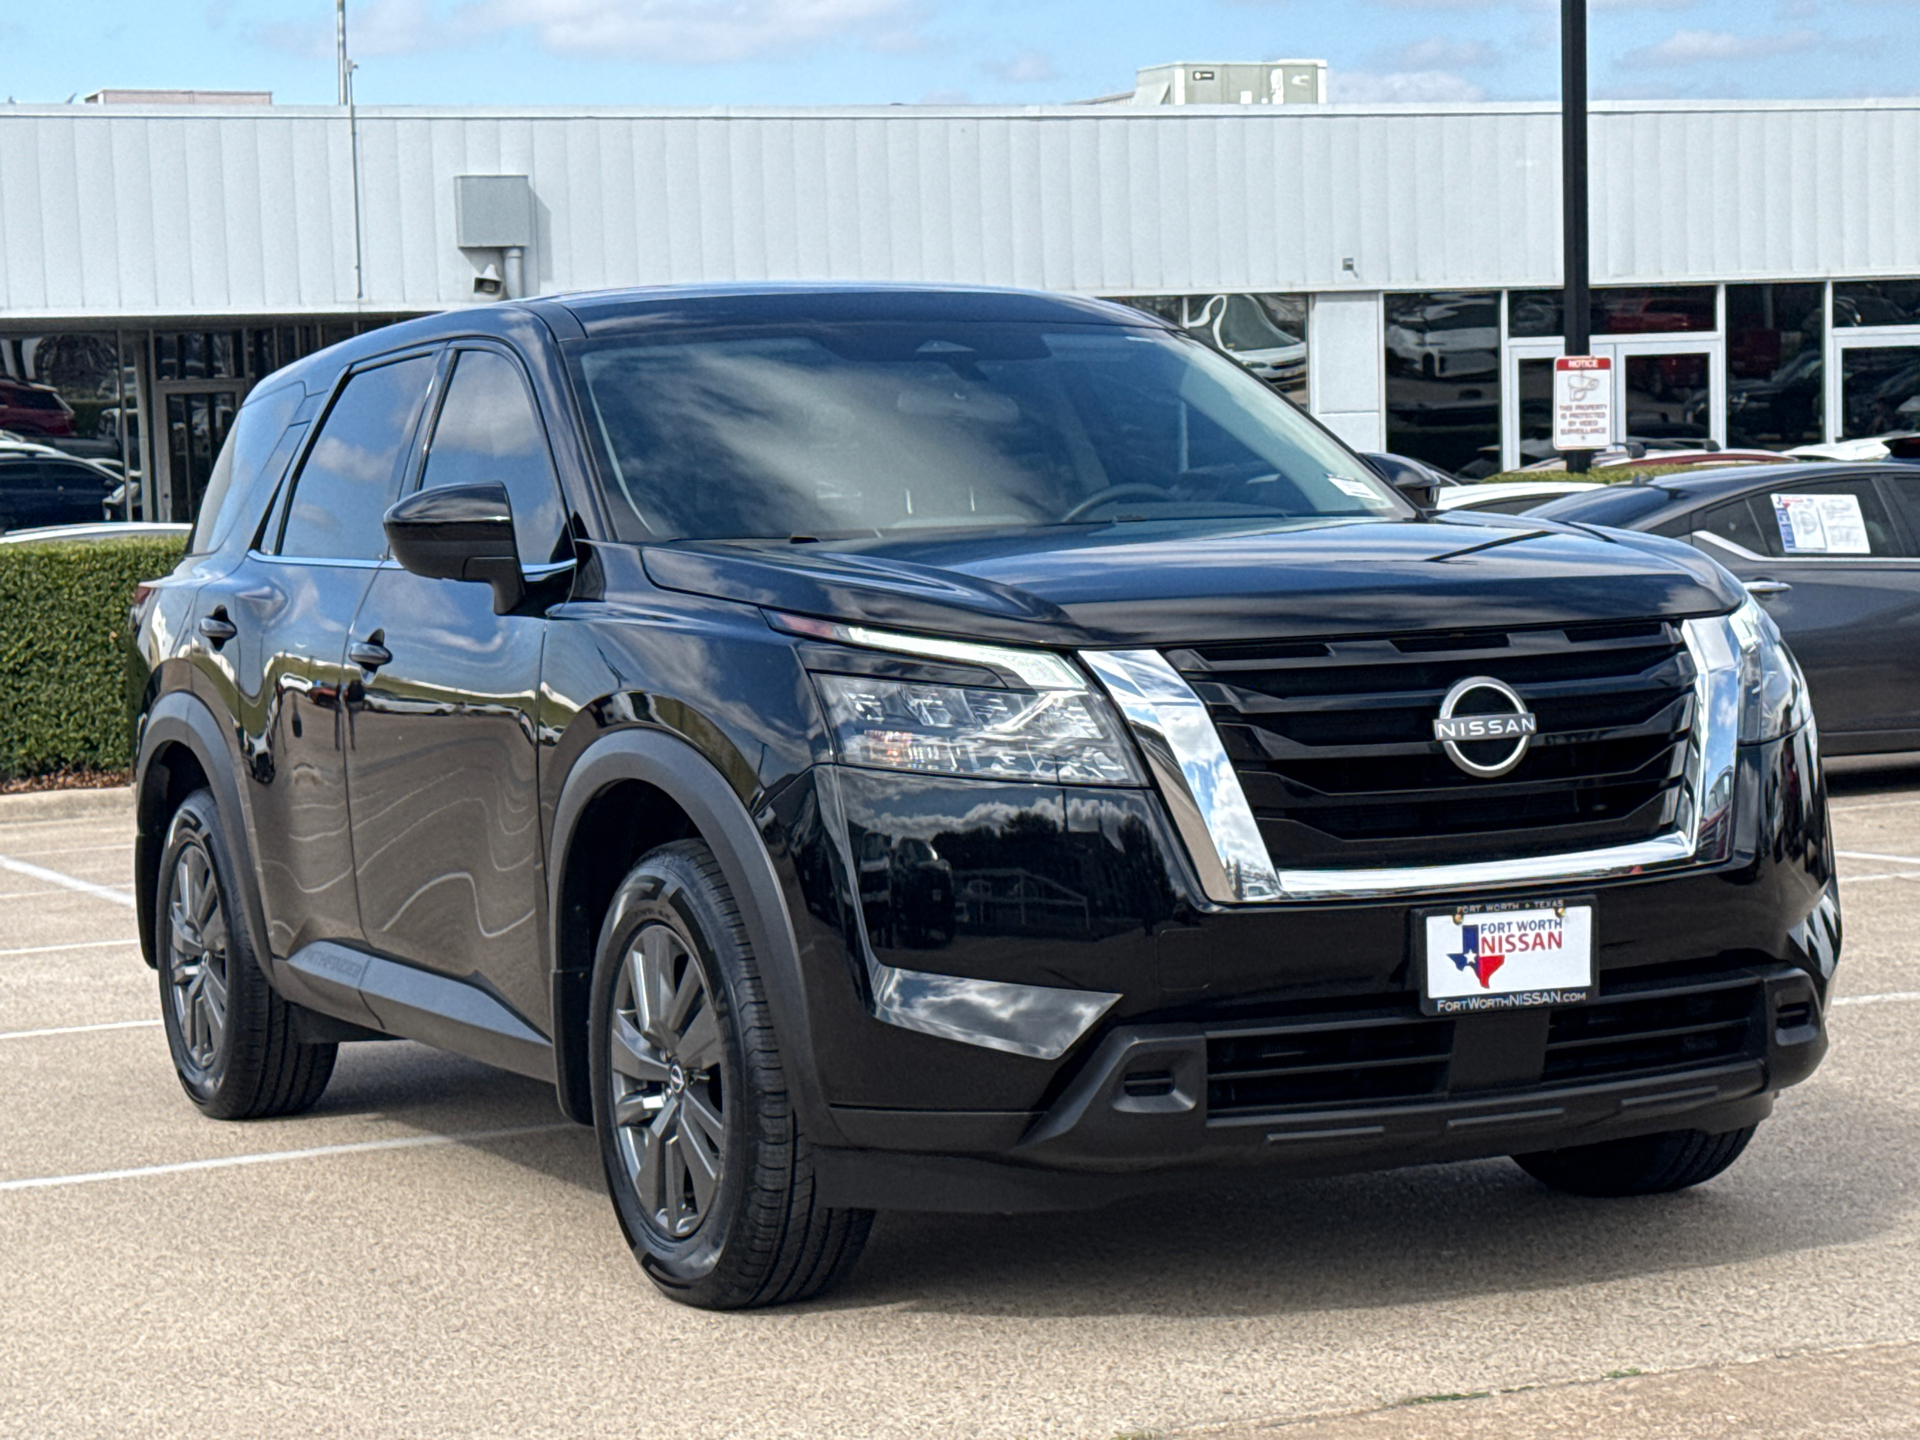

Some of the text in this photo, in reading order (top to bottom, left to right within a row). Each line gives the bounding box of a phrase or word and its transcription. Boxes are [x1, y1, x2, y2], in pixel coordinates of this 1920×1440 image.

[1568, 359, 1599, 368] NOTICE
[1569, 411, 1606, 419] PROTECTED
[1560, 427, 1606, 435] SURVEILLANCE
[1437, 717, 1535, 738] NISSAN
[1457, 900, 1564, 914] FORT WORTH TEXAS
[1481, 919, 1563, 934] FORT WORTH
[1481, 931, 1563, 954] NISSAN
